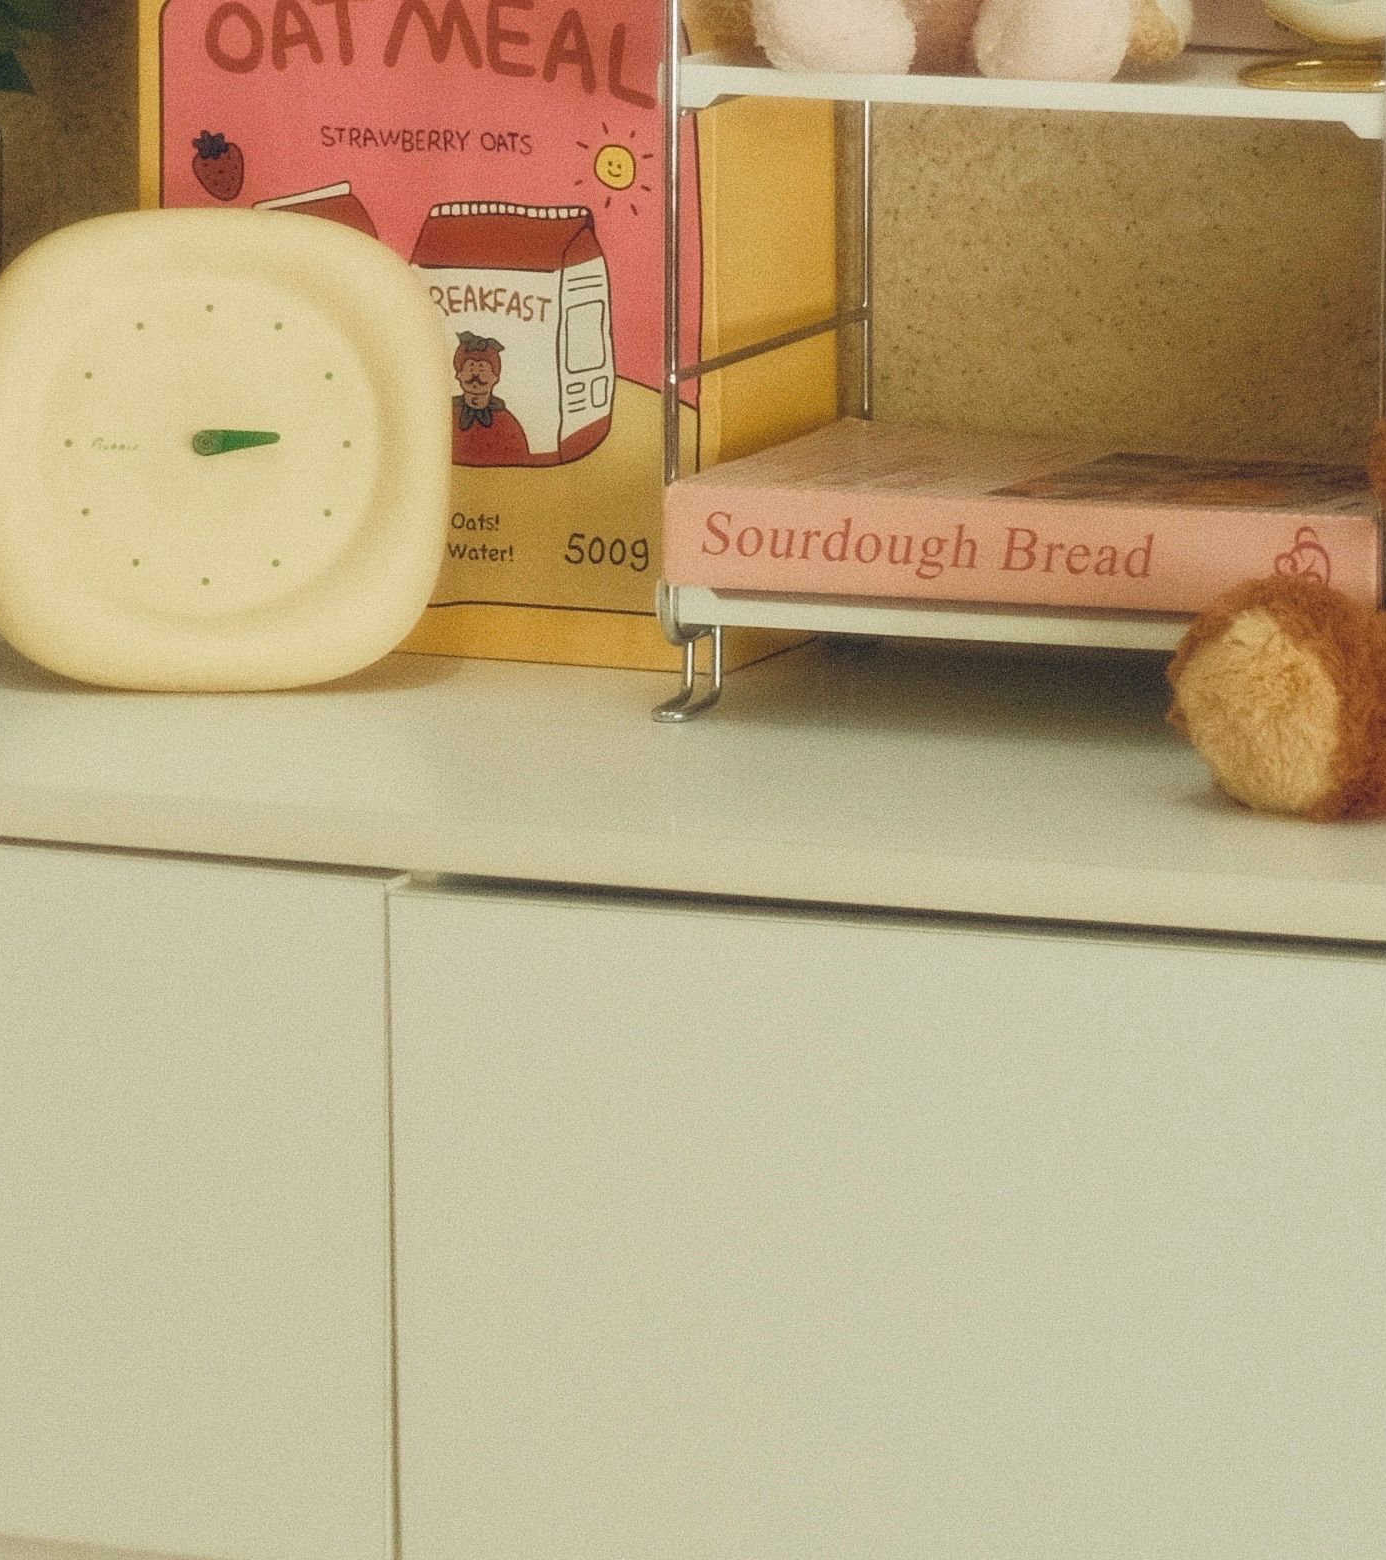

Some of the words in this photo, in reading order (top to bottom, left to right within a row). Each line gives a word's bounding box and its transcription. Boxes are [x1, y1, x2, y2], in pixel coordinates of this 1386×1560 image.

[320, 125, 471, 153] STRAWBERRY
[480, 131, 533, 156] OATS
[428, 284, 553, 323] REAKFAST
[450, 511, 500, 532] Oats!
[447, 542, 515, 563] Water!
[563, 532, 650, 573] 500g
[701, 510, 979, 581] Sourdough
[1002, 526, 1156, 580] Bread
